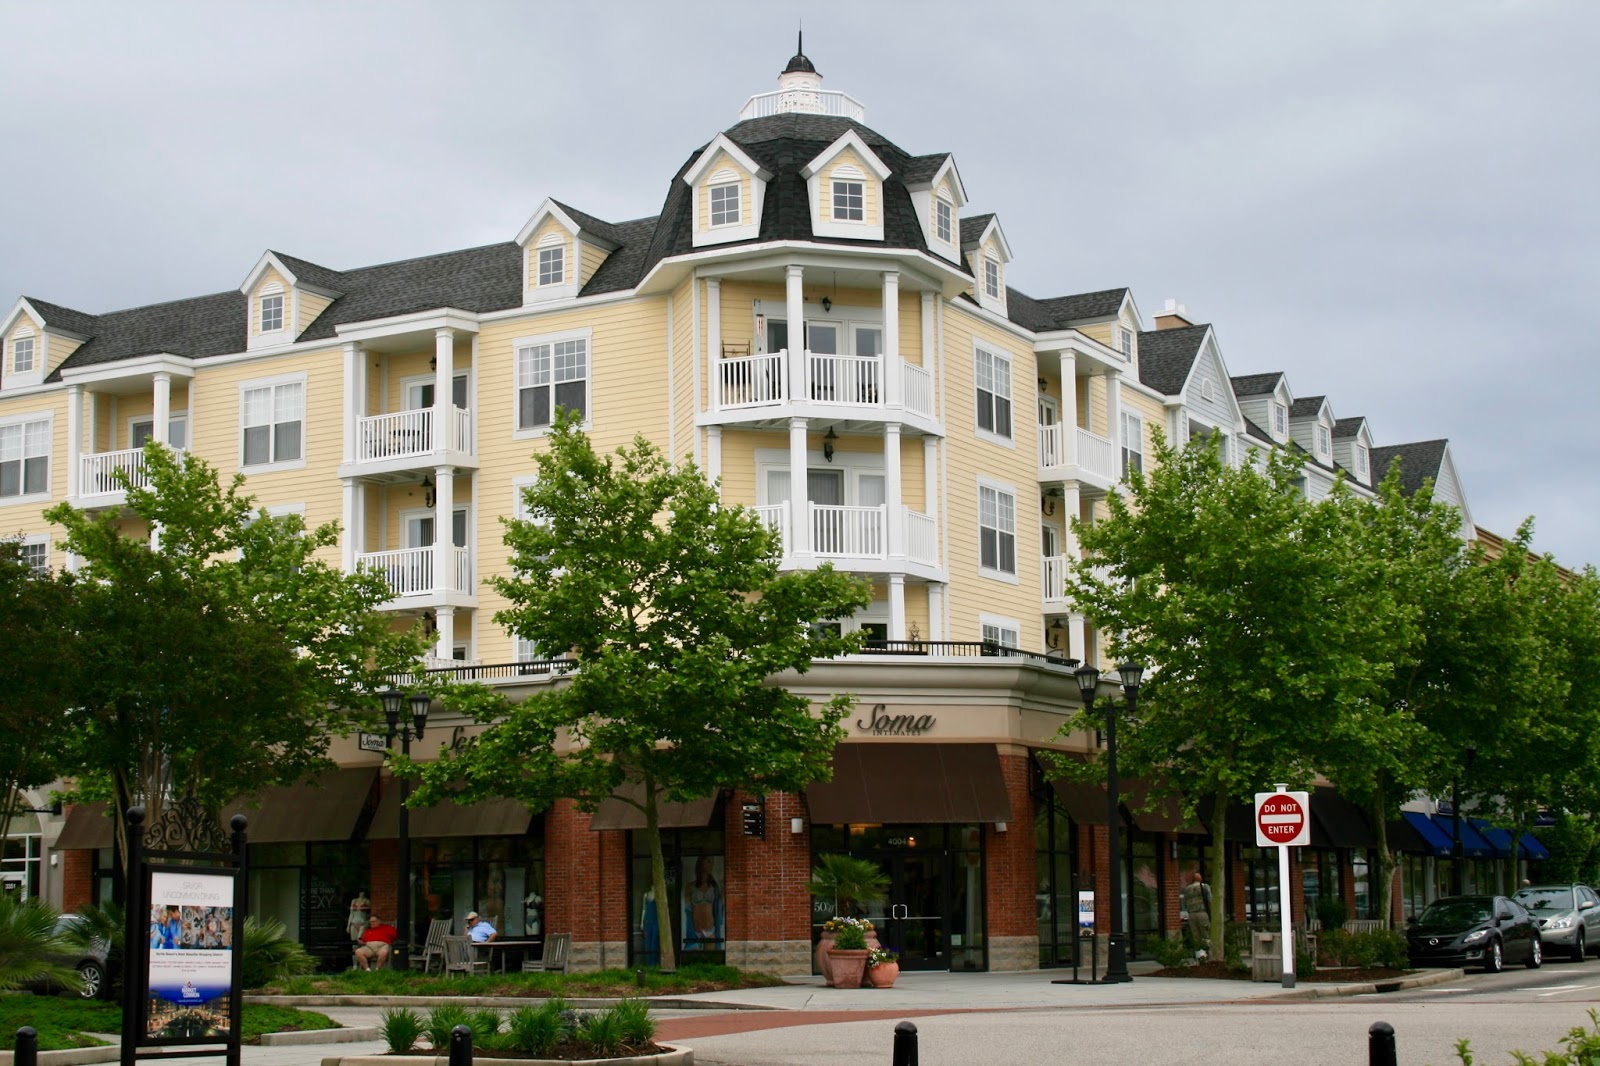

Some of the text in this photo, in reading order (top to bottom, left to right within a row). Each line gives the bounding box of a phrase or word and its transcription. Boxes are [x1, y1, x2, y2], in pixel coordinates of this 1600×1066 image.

[857, 704, 936, 731] Soma
[362, 734, 385, 747] Soma
[182, 882, 203, 890] SAVOR
[301, 895, 335, 909] SEXY
